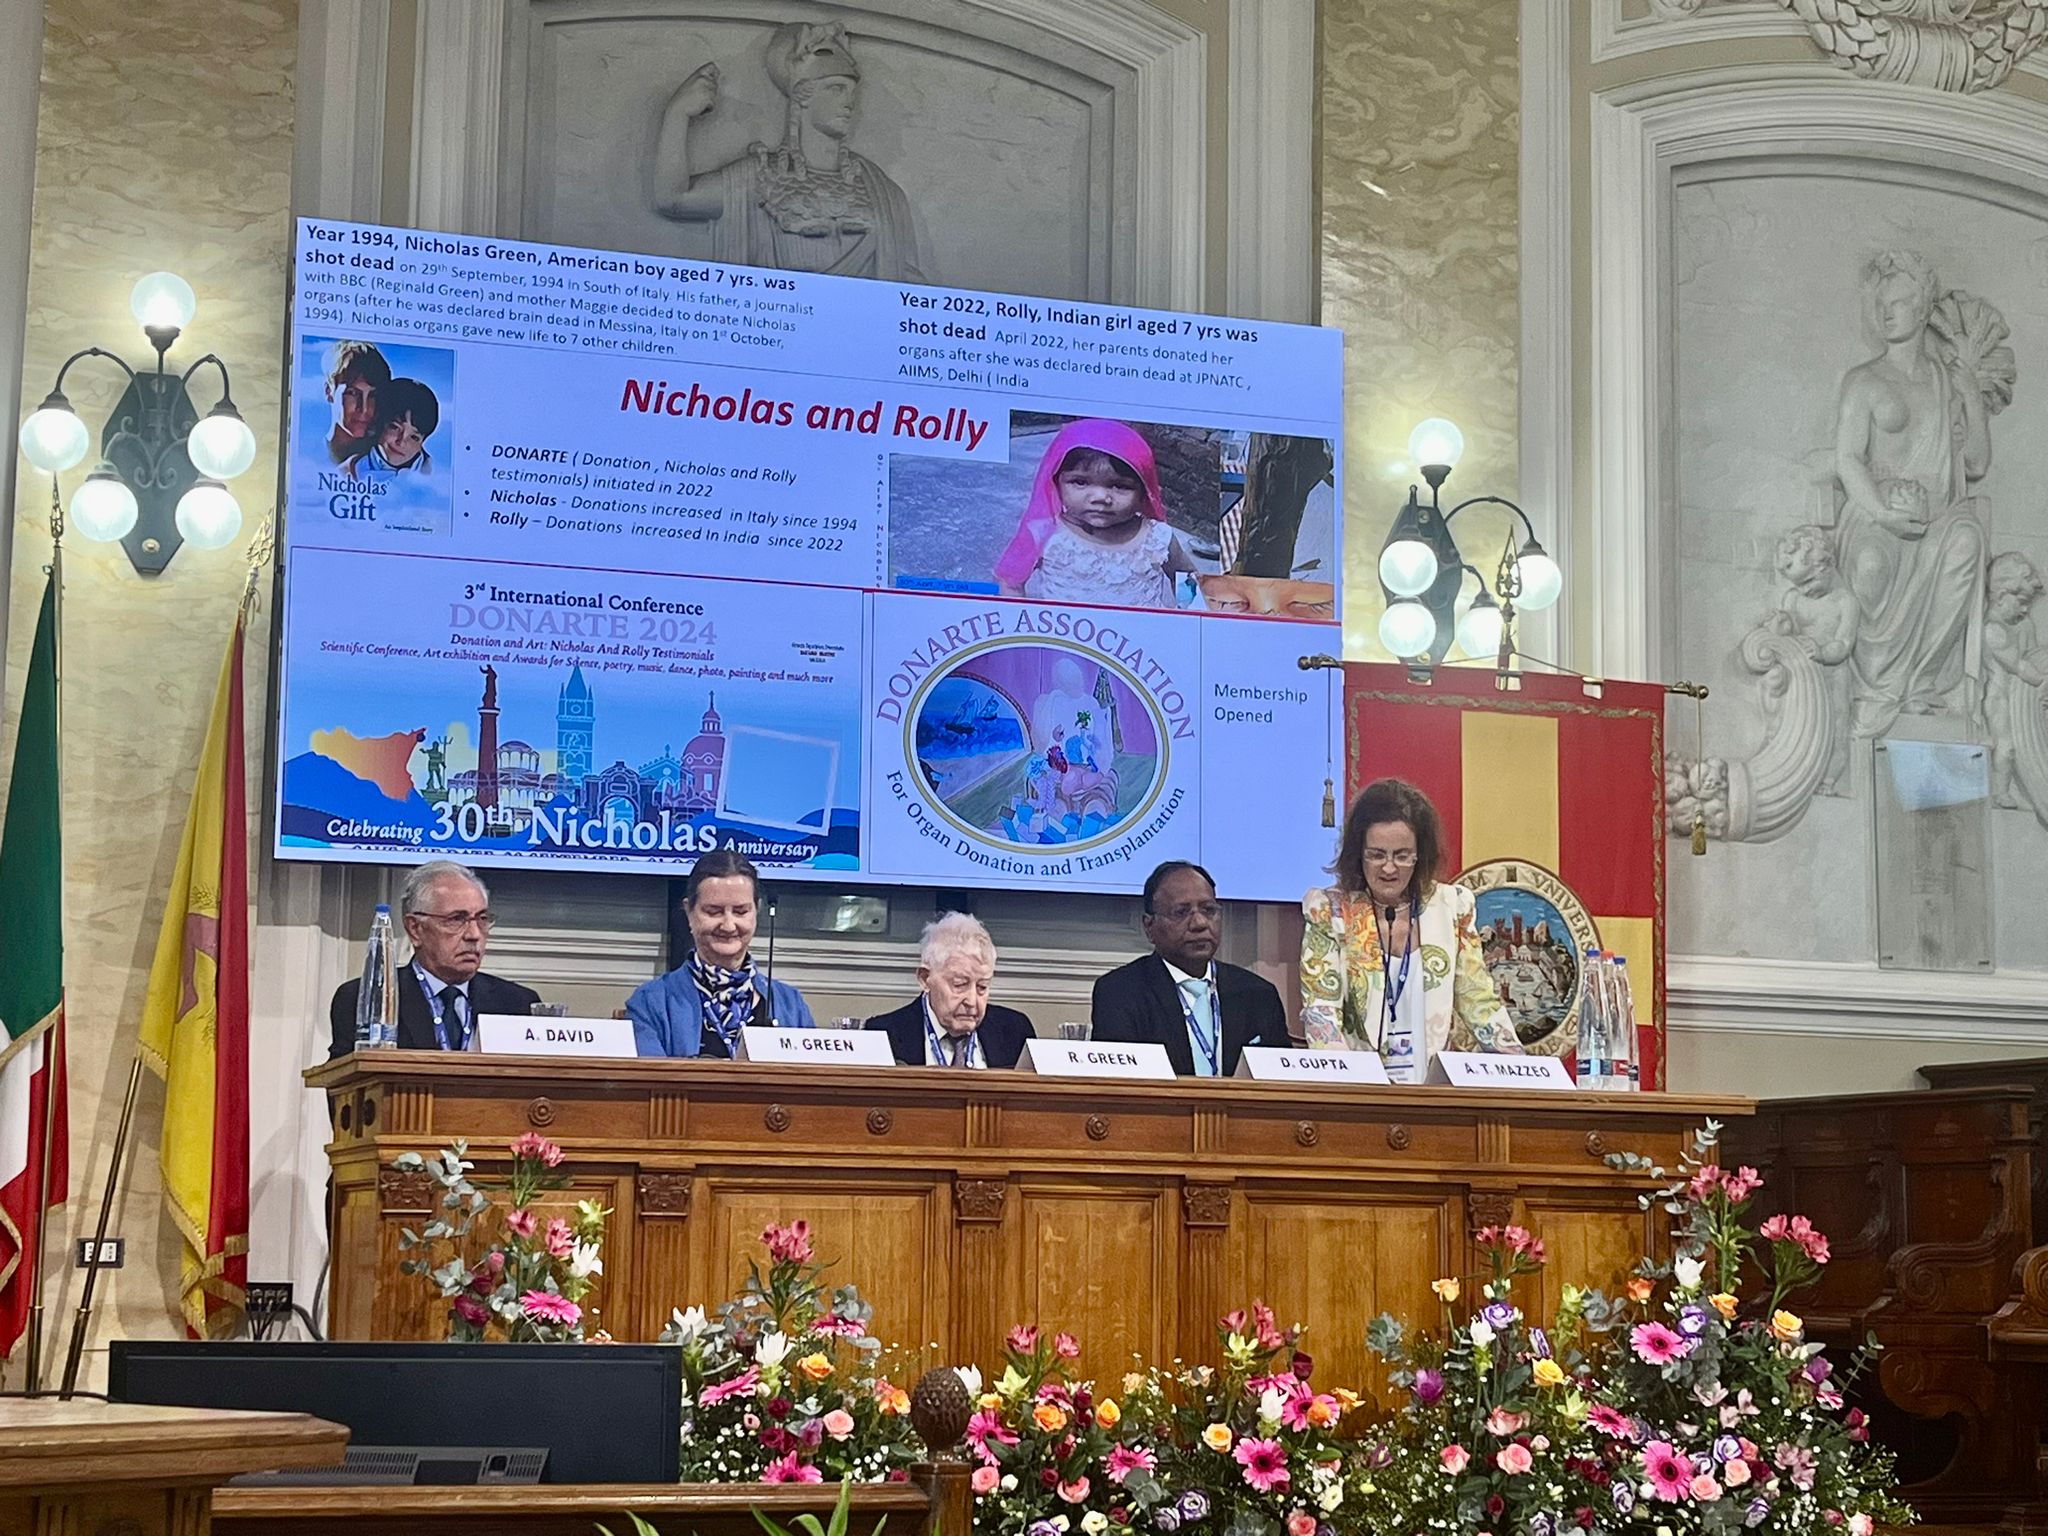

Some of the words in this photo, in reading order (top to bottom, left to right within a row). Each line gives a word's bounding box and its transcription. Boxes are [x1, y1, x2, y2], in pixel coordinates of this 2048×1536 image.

[307, 225, 345, 242] Year
[351, 229, 399, 250] 1994,
[405, 235, 480, 258] Nicholas
[485, 245, 542, 267] Green,
[547, 252, 629, 273] American
[635, 260, 665, 280] boy
[670, 266, 709, 283] aged
[716, 269, 725, 283] 7
[729, 274, 758, 288] yrs.
[763, 278, 796, 291] was
[305, 248, 345, 266] shot
[350, 253, 394, 271] dead
[421, 263, 448, 276] 29th
[451, 267, 527, 288] September,
[532, 275, 563, 289] 1994
[584, 281, 621, 295] South
[677, 291, 696, 303] His
[700, 293, 740, 310] father,
[304, 272, 335, 285] with
[340, 275, 367, 288] BBC
[371, 276, 434, 296] (Reginald
[438, 283, 484, 302] Green)
[488, 290, 513, 303] and
[517, 294, 566, 309] mother
[570, 297, 618, 315] Maggie
[622, 303, 673, 319] decided
[694, 311, 739, 326] donate
[743, 315, 796, 332] Nicholas
[304, 290, 350, 304] organs
[355, 292, 392, 307] (after
[417, 302, 443, 313] was
[447, 304, 505, 320] declared
[509, 309, 543, 324] brain
[547, 313, 580, 328] dead
[599, 319, 657, 337] Messina,
[661, 325, 688, 340] Italy
[731, 331, 784, 350] October,
[900, 291, 938, 309] Year
[943, 296, 990, 317] 2022,
[996, 302, 1042, 323] Rolly,
[1047, 307, 1100, 326] Indian
[1105, 313, 1132, 331] girl
[1137, 319, 1177, 335] aged
[1182, 321, 1192, 335] 7
[1196, 325, 1221, 341] yrs
[1226, 328, 1258, 342] was
[352, 311, 409, 328] Nicholas
[413, 320, 458, 334] organs
[462, 325, 492, 338] gave
[497, 328, 525, 340] new
[529, 327, 549, 342] life
[582, 336, 618, 350] other
[899, 318, 938, 335] shot
[943, 322, 986, 340] dead
[994, 330, 1027, 346] April
[1030, 334, 1068, 351] 2022,
[1073, 338, 1095, 351] her
[1099, 343, 1149, 358] parents
[1153, 346, 1207, 363] donated
[1211, 352, 1234, 365] her
[898, 364, 943, 382] AIIMS,
[948, 368, 983, 383] Delhi
[996, 374, 1029, 388] India
[899, 345, 945, 360] organs
[949, 348, 981, 362] after
[985, 351, 1010, 366] she
[1013, 355, 1040, 368] was
[1043, 358, 1101, 374] declared
[1105, 362, 1139, 378] brain
[1143, 366, 1175, 382] dead
[1179, 372, 1193, 383] at
[620, 378, 794, 426] Nicholas
[805, 400, 883, 434] and
[893, 404, 989, 452] Rolly
[491, 444, 569, 464] DONARTE
[582, 452, 651, 470] Donation
[664, 459, 726, 477] Nicholas
[730, 467, 758, 480] and
[762, 468, 797, 486] Rolly
[491, 467, 589, 490] testimonials)
[593, 476, 655, 493] initiated
[658, 481, 672, 494] in
[676, 483, 713, 497] 2022
[329, 494, 376, 521] Gift
[490, 489, 557, 507] Nicholas
[571, 496, 647, 515] Donations
[651, 503, 722, 520] increased
[730, 507, 743, 521] in
[747, 510, 779, 528] Italy
[782, 514, 818, 528] since
[822, 516, 858, 531] 1994
[489, 511, 529, 530] Rolly
[546, 516, 623, 534] Donations
[631, 521, 701, 540] increased
[723, 530, 760, 545] India
[767, 534, 803, 549] since
[807, 537, 843, 551] 2022
[465, 583, 485, 600] 3rd
[490, 586, 603, 609] International
[609, 595, 703, 615] Conference
[449, 603, 629, 639] DONARTE
[640, 616, 717, 645] 2024
[320, 641, 364, 656] Scientific
[366, 643, 420, 657] Conference,
[423, 648, 441, 658] Art
[443, 649, 490, 661] exhibition
[492, 652, 510, 662] and
[512, 654, 547, 665] Awards
[548, 655, 563, 668] for
[728, 667, 766, 682] painting
[768, 670, 785, 680] and
[787, 672, 809, 682] much
[812, 675, 833, 683] more
[451, 633, 500, 647] Donation
[504, 637, 523, 649] and
[550, 640, 594, 653] Nicholas
[597, 643, 619, 655] And
[622, 645, 650, 660] Rolly
[652, 647, 714, 661] Testimonials
[876, 611, 1005, 726] DONARTE
[1013, 609, 1196, 740] ASSOCIATION
[1214, 683, 1308, 705] Membership
[1214, 707, 1273, 724] Opened
[326, 818, 423, 845] Celebrating
[430, 801, 513, 843] 30th
[528, 806, 718, 852] Nicholas
[724, 838, 819, 860] Anniversary
[886, 769, 909, 800] For
[907, 802, 953, 848] Organ
[954, 840, 1035, 876] Donation
[1040, 860, 1072, 876] and
[1075, 786, 1186, 874] Transplantation
[525, 1028, 540, 1041] A.
[546, 1029, 594, 1043] DAVID
[780, 1037, 798, 1050] M.
[802, 1038, 854, 1052] GREEN
[1068, 1051, 1083, 1064] R.
[1087, 1052, 1138, 1066] GREEN
[1280, 1057, 1296, 1069] D.
[1299, 1057, 1348, 1070] GUPTA
[1464, 1062, 1479, 1075] A.
[1479, 1063, 1493, 1075] T.
[1495, 1064, 1551, 1078] MAZZEO
